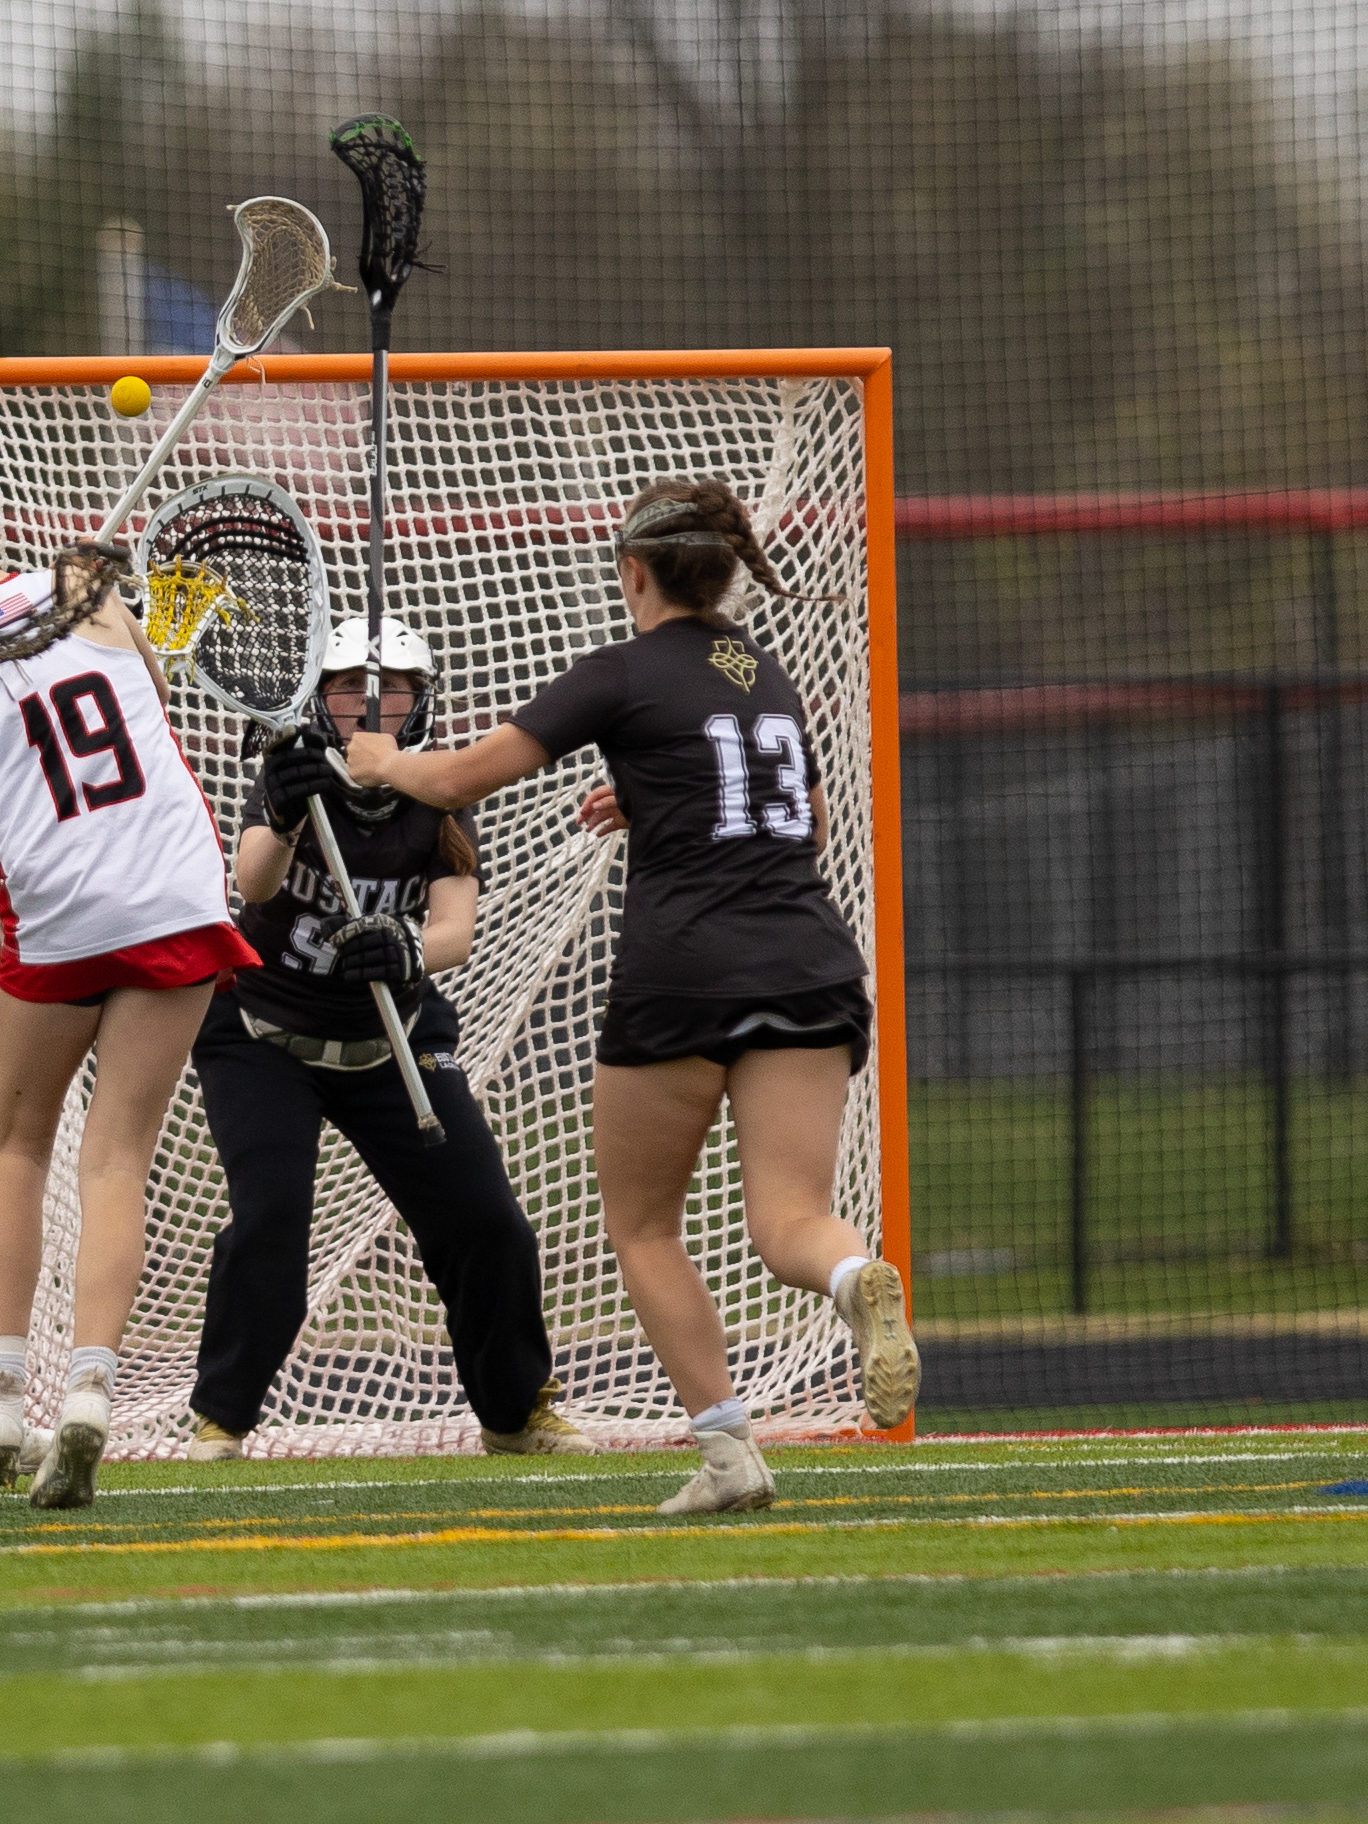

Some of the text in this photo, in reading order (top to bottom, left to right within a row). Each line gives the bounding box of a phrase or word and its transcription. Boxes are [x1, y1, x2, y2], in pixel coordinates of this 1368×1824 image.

[19, 670, 147, 823] 19
[704, 713, 813, 843] 13
[282, 860, 429, 916] USTAC
